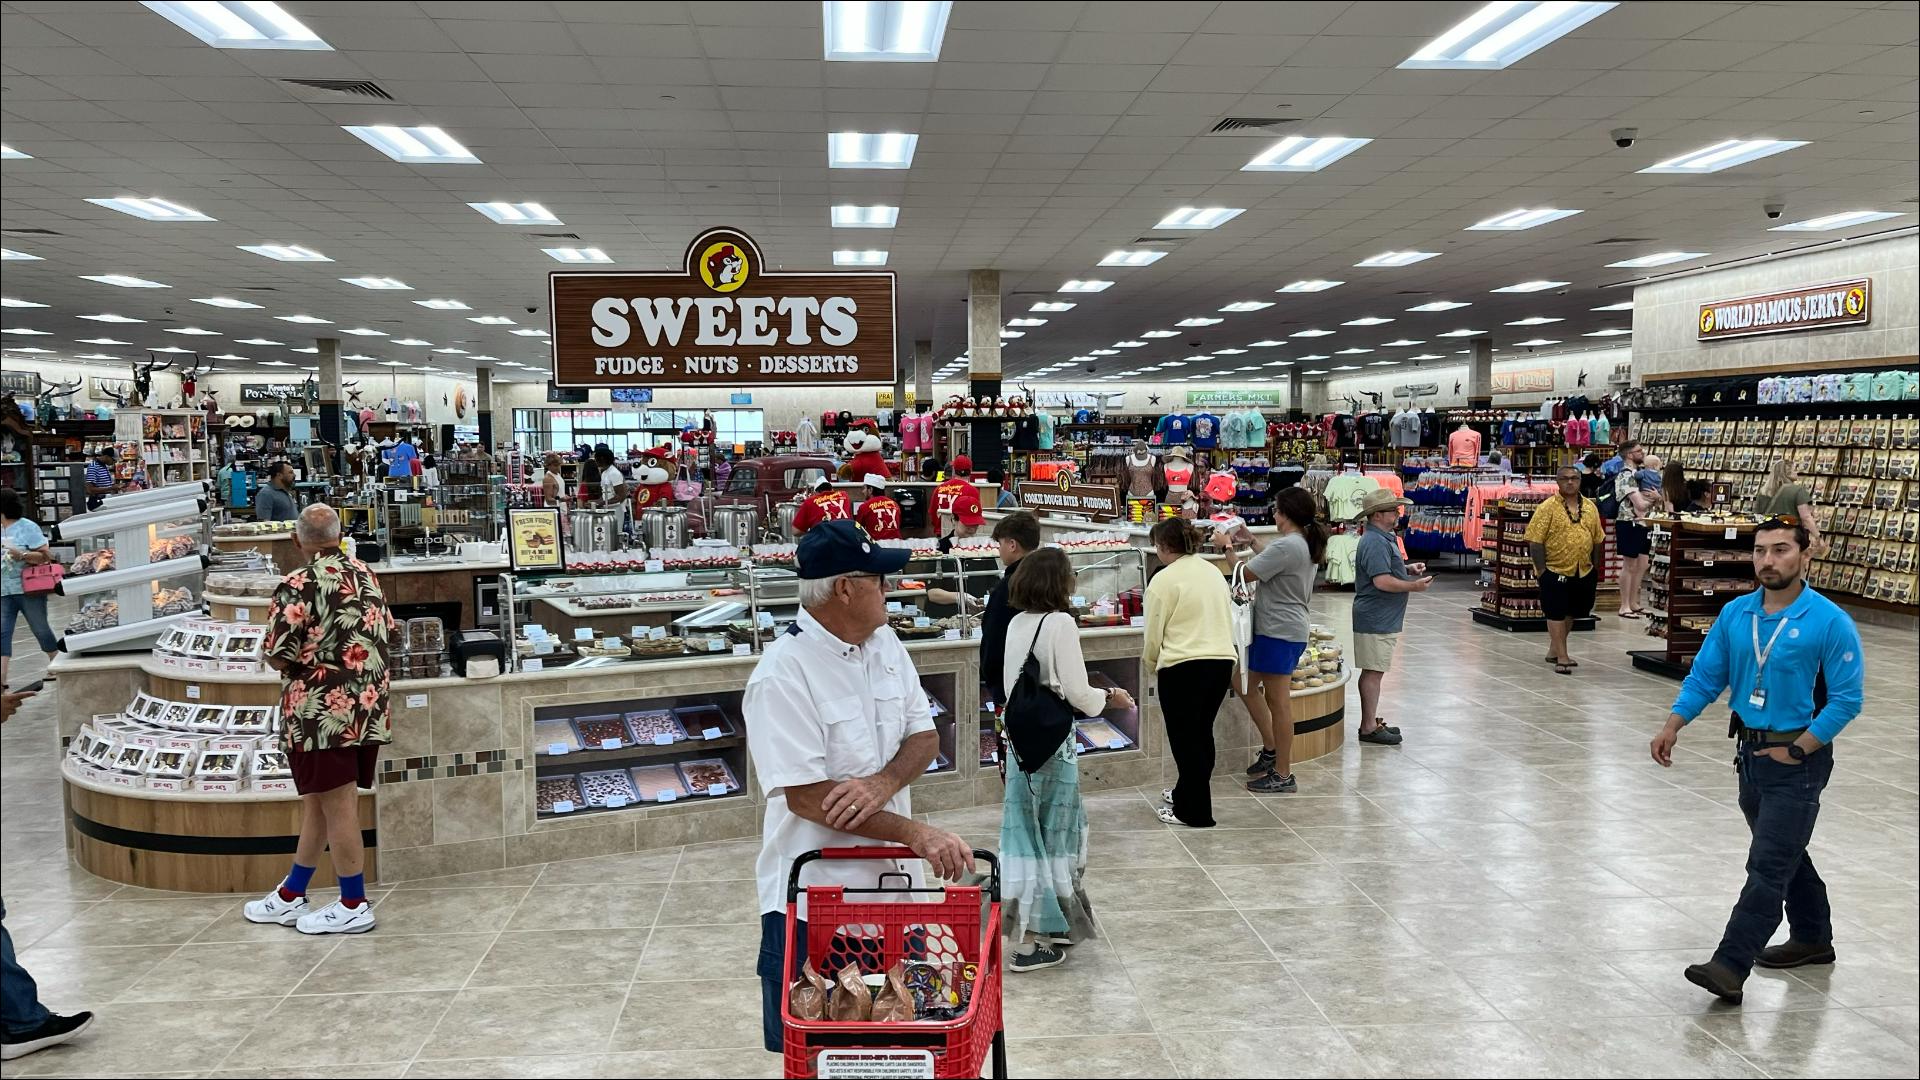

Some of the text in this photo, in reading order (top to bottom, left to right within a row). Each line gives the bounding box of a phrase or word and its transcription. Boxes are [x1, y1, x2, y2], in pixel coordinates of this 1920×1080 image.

[1714, 290, 1847, 331] WORLD FAMOUS JERKY
[591, 296, 859, 348] SWEETS
[594, 356, 859, 375] FUDGE NUTS DESSERTS
[1, 376, 35, 392] MITH
[1517, 374, 1551, 388] OFFICE
[1024, 493, 1044, 504] COOKIE
[1044, 494, 1063, 506] DOUGH
[1082, 496, 1112, 510] PUDDINGS
[872, 508, 898, 529] TX
[265, 901, 275, 912] N
[325, 912, 336, 922] N
